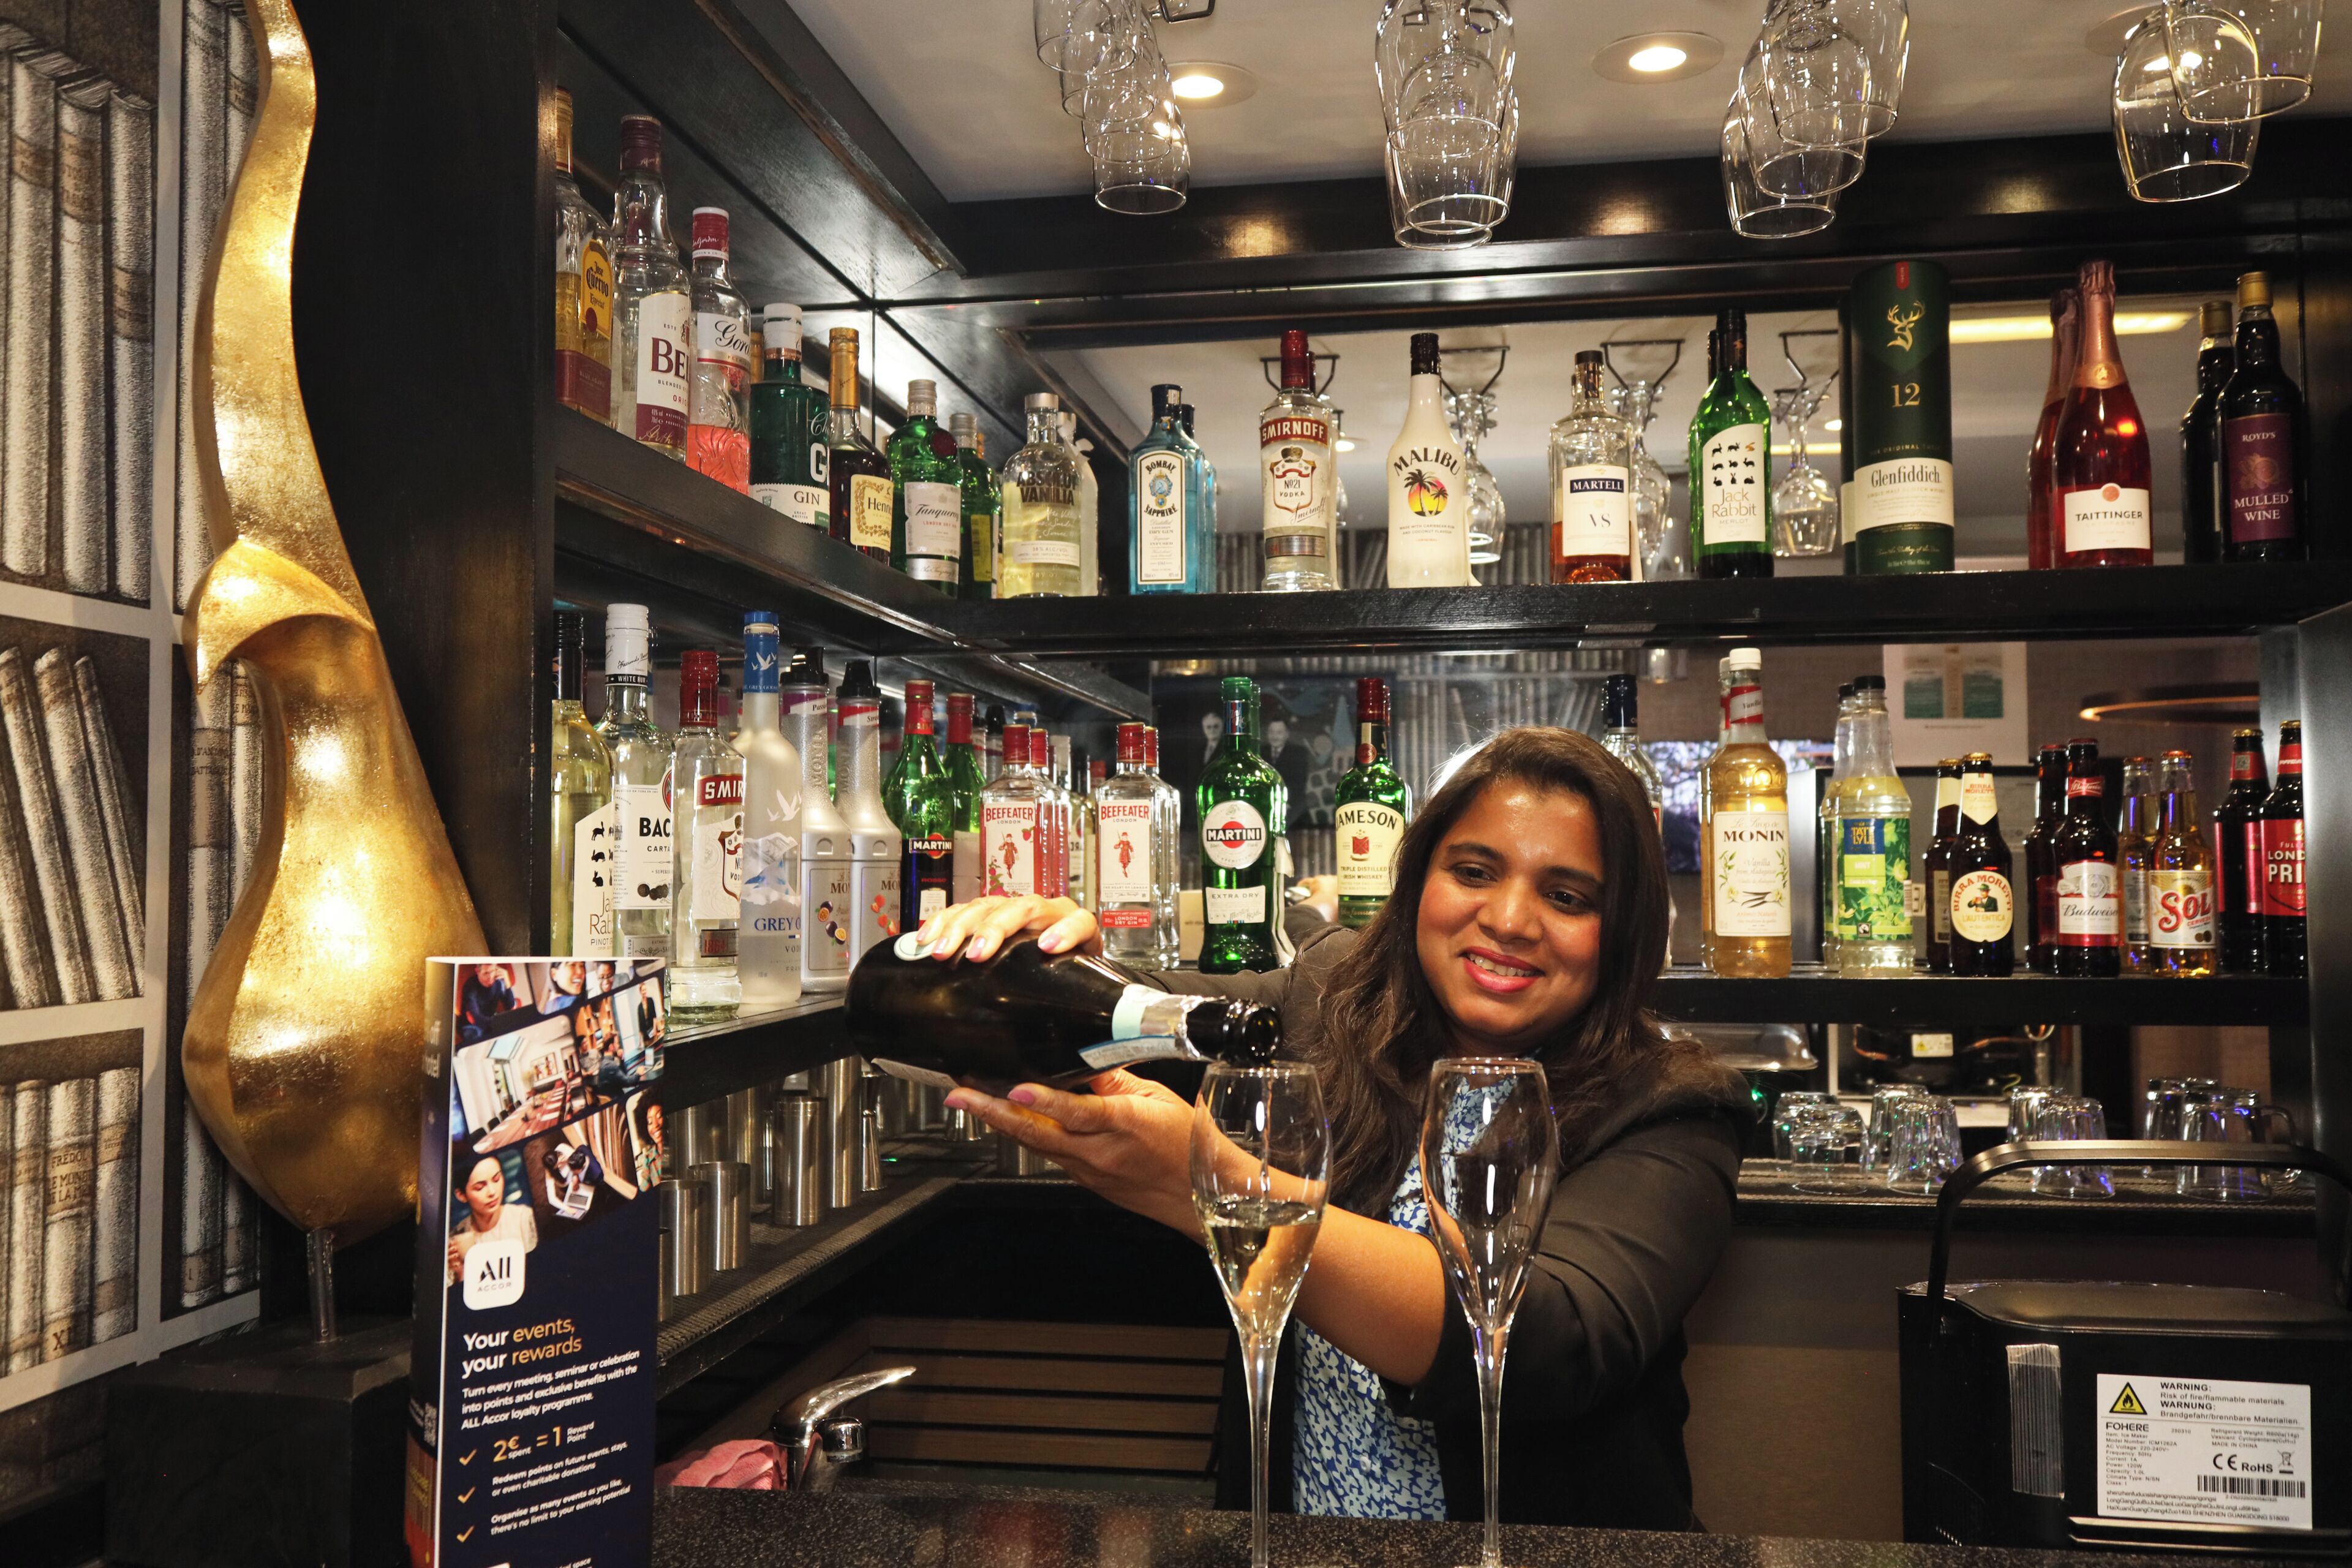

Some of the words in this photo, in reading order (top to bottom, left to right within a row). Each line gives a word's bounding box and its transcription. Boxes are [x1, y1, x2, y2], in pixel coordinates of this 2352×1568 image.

[586, 268, 609, 298] Cuervo
[658, 379, 682, 390] BLENDED
[1891, 382, 1921, 408] 12
[1262, 421, 1325, 442] SMIRNOFF
[2242, 431, 2276, 443] ROYD'S
[1145, 460, 1177, 474] BOMBAY
[1393, 447, 1461, 477] MALIBU
[1016, 470, 1078, 490] ABSOLUT
[1871, 464, 1942, 488] Glenfiddich
[1572, 480, 1623, 491] MARTELL
[793, 490, 820, 506] GIN
[1720, 487, 1750, 507] Jack
[2234, 494, 2290, 509] MULLED
[1144, 503, 1178, 518] SAPPHIRE
[1712, 501, 1757, 519] Rabbit
[2075, 510, 2143, 522] TAITTINGER
[2244, 509, 2281, 522] WINE
[1589, 513, 1611, 528] VS
[986, 807, 1034, 823] BEEFEATER
[1101, 805, 1150, 821] BEEFEATER
[1335, 809, 1398, 832] JAMESON
[639, 817, 671, 838] BAC
[1207, 828, 1261, 841] MARTINI
[1724, 830, 1785, 843] MONIN
[913, 840, 952, 851] MARTINI
[1744, 857, 1771, 867] Vanilla
[2267, 850, 2305, 861] LOND
[2267, 863, 2303, 884] PRI
[830, 882, 850, 894] MO
[881, 880, 900, 891] MO
[1953, 876, 1975, 912] BIRRA
[1976, 874, 2013, 911] MORETTI
[2062, 903, 2119, 917] Budweise
[2158, 891, 2212, 934] SOL
[589, 913, 612, 935] Rab
[754, 917, 793, 932] GREY
[590, 938, 609, 946] PINOT
[51, 1150, 88, 1169] FREDOL
[478, 1256, 511, 1283] All
[477, 1281, 511, 1292] ACCOR
[463, 1328, 510, 1352] Your
[513, 1317, 575, 1343] events,
[461, 1353, 508, 1379] your
[512, 1336, 582, 1366] rewards
[462, 1385, 486, 1398] Turn
[486, 1381, 513, 1393] every
[514, 1371, 554, 1389] meeting,
[554, 1363, 589, 1379] seminar
[589, 1361, 600, 1371] or
[599, 1349, 640, 1368] celebration
[462, 1401, 483, 1414] into
[483, 1395, 514, 1412] points
[514, 1389, 533, 1403] and
[534, 1381, 573, 1399] exclusive
[574, 1372, 606, 1390] benefits
[606, 1367, 625, 1381] with
[625, 1364, 638, 1376] the
[2160, 1381, 2212, 1392] WARNING:
[2160, 1400, 2216, 1411] WARNUNG:
[2190, 1393, 2246, 1404] fire/flammable
[461, 1416, 481, 1430] ALL
[481, 1411, 511, 1426] Accor
[511, 1404, 541, 1420] loyalty
[541, 1392, 594, 1414] programme.
[2160, 1410, 2252, 1422] Brandgefahr/brennbare
[552, 1425, 562, 1448] 1
[566, 1420, 595, 1436] Reward
[2105, 1422, 2150, 1433] FOHERE
[507, 1446, 532, 1460] spent
[566, 1431, 587, 1445] Point
[492, 1470, 527, 1487] Redeem
[527, 1463, 554, 1479] points
[554, 1460, 565, 1470] on
[564, 1452, 587, 1467] future
[2241, 1462, 2274, 1474] RoHS
[491, 1487, 501, 1498] or
[502, 1482, 521, 1494] even
[522, 1472, 560, 1490] charitable
[560, 1461, 597, 1479] donations
[491, 1507, 529, 1525] Organise
[529, 1504, 540, 1515] as
[540, 1498, 563, 1512] many
[562, 1490, 588, 1504] events
[587, 1487, 597, 1497] as
[596, 1482, 610, 1496] you
[491, 1521, 518, 1536] there's
[518, 1518, 530, 1529] no
[530, 1512, 549, 1525] limit
[549, 1509, 559, 1519] to
[558, 1504, 576, 1518] your
[575, 1496, 603, 1512] earning
[602, 1484, 631, 1504] potential
[2192, 1509, 2226, 1518] SHENZHEN
